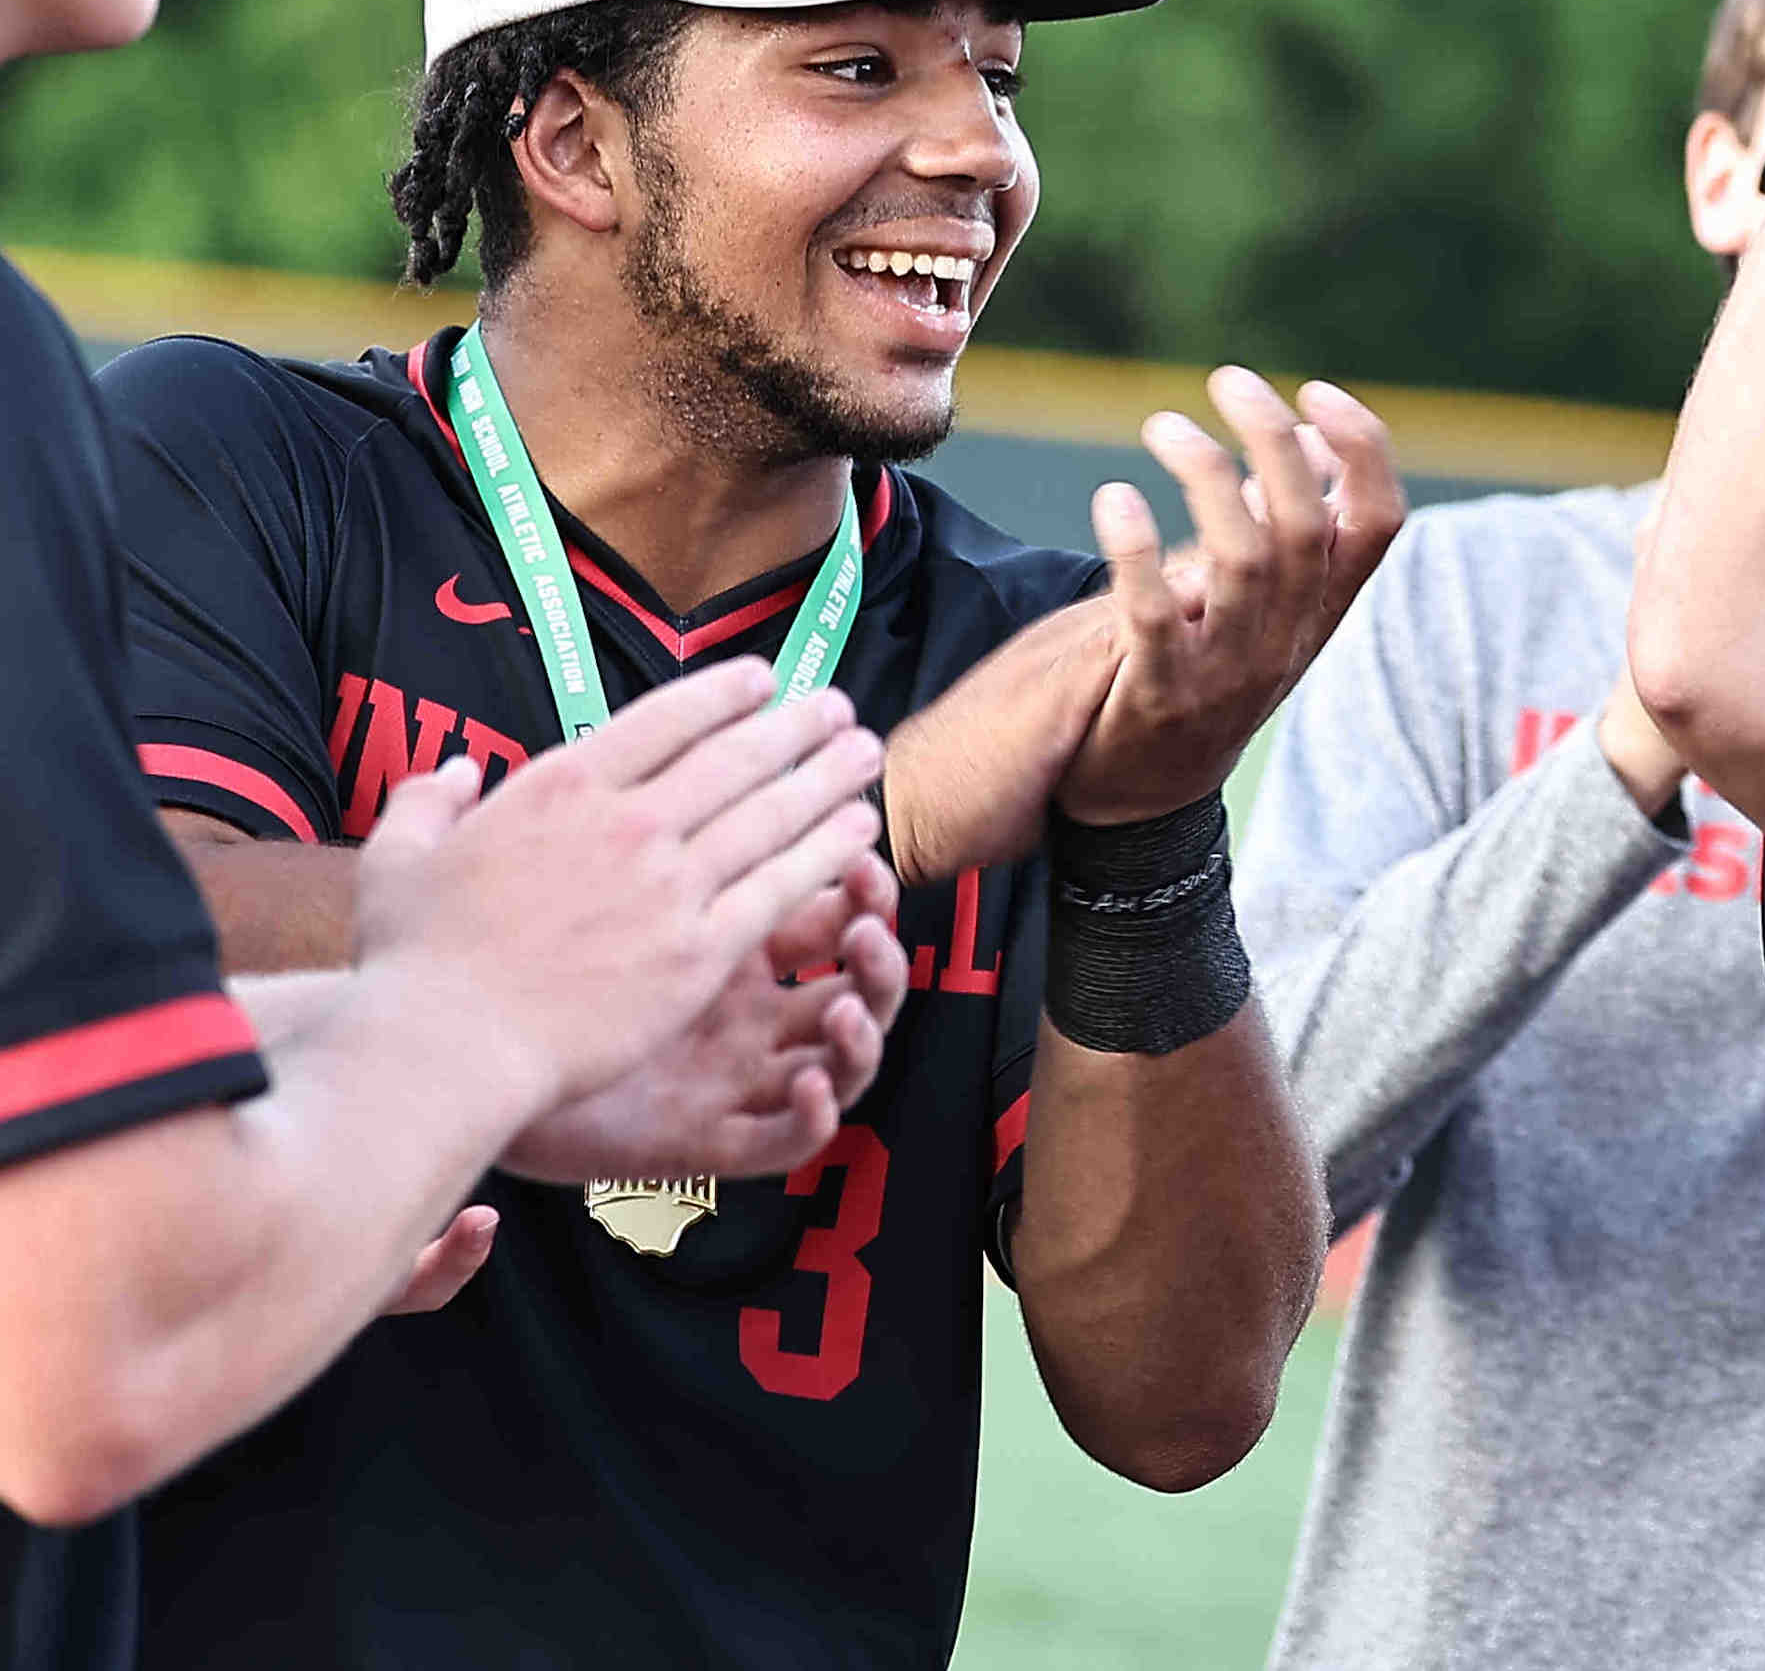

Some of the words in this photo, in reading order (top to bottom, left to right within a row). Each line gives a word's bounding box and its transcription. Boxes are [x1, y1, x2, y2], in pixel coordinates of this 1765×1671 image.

[471, 414, 511, 478] SCHOOL
[496, 482, 548, 565] ATHLETIC
[531, 573, 588, 695] ASSOCIATION
[818, 552, 859, 631] ATHLETIC
[739, 1124, 889, 1401] 3
